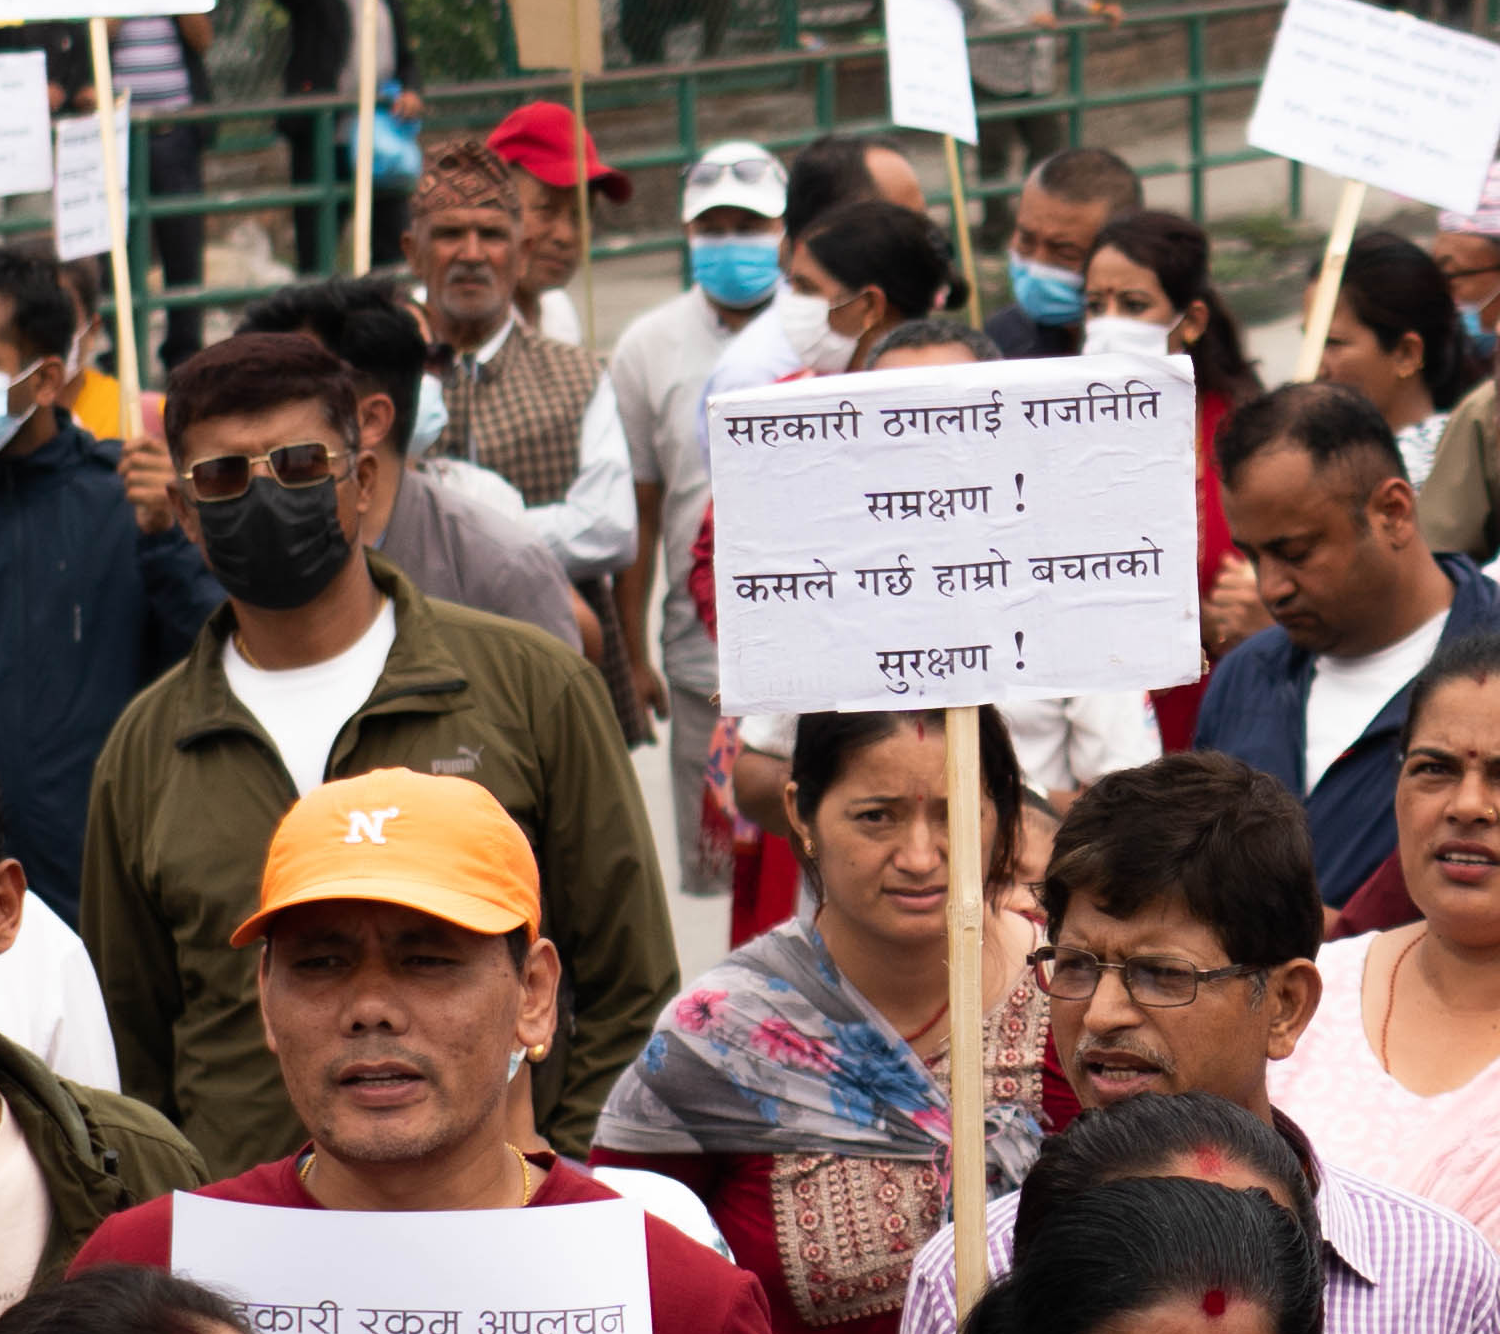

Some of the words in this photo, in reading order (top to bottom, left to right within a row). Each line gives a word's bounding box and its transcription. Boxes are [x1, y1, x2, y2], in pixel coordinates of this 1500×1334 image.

[724, 401, 863, 447] सहकारी
[880, 390, 1004, 439] ठगलाई
[1021, 380, 1161, 428] राजनिति
[732, 559, 837, 602] कसले
[854, 554, 915, 596] गर्छ
[932, 548, 1012, 597] हाम्रो
[1028, 537, 1164, 584] बचतको
[876, 645, 992, 695] सुरक्षण
